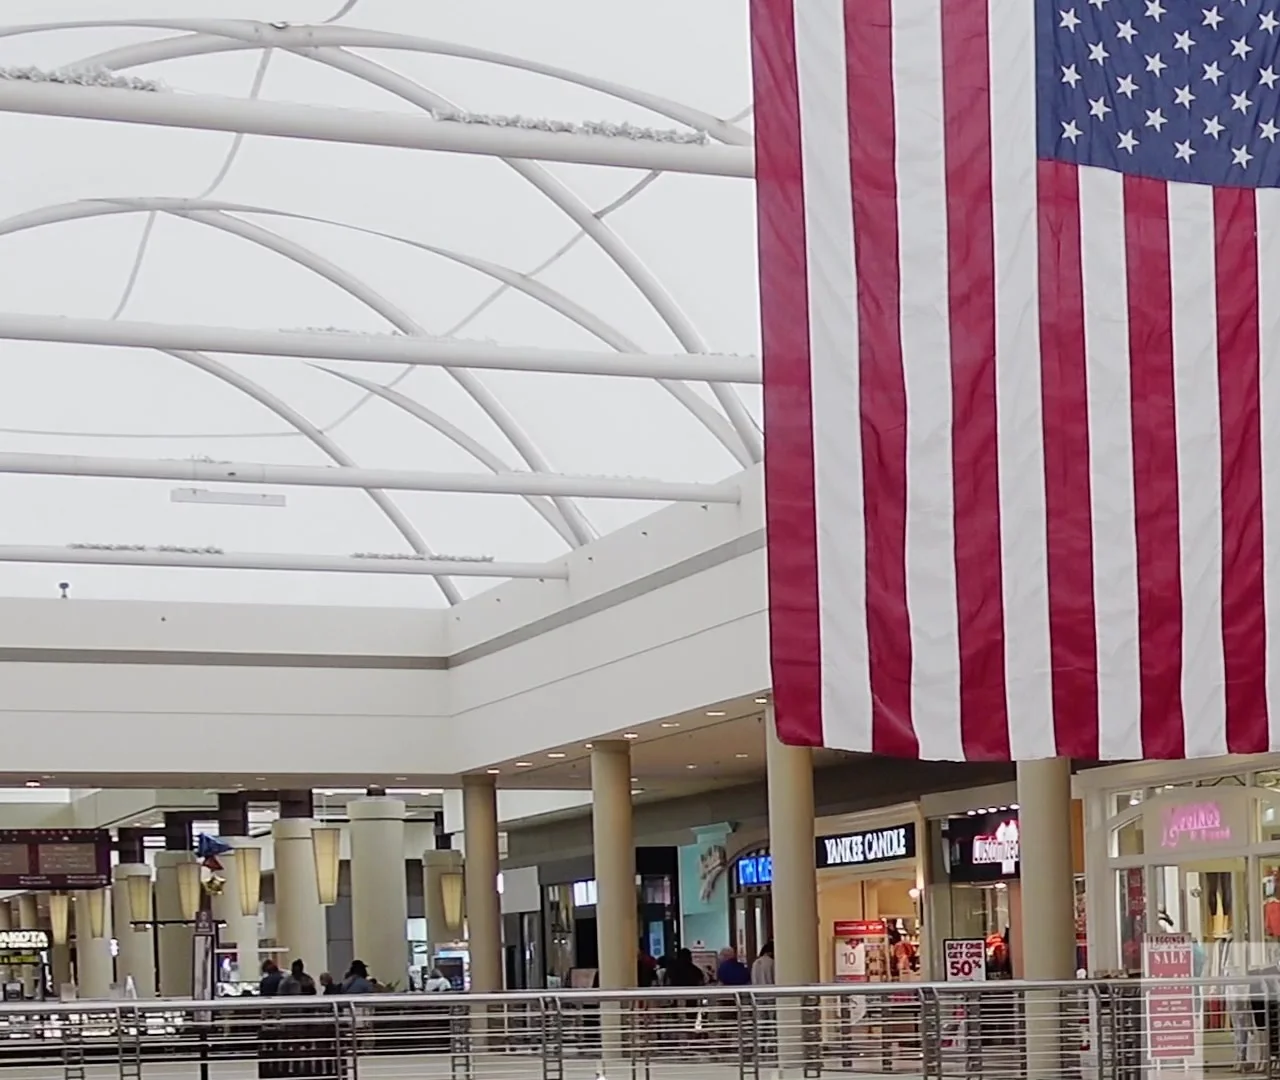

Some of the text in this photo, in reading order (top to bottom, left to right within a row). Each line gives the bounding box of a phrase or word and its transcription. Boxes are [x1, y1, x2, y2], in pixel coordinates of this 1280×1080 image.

[824, 828, 906, 864] YANKEE CANDLE
[1154, 951, 1187, 965] SALE
[950, 960, 982, 977] 50%
